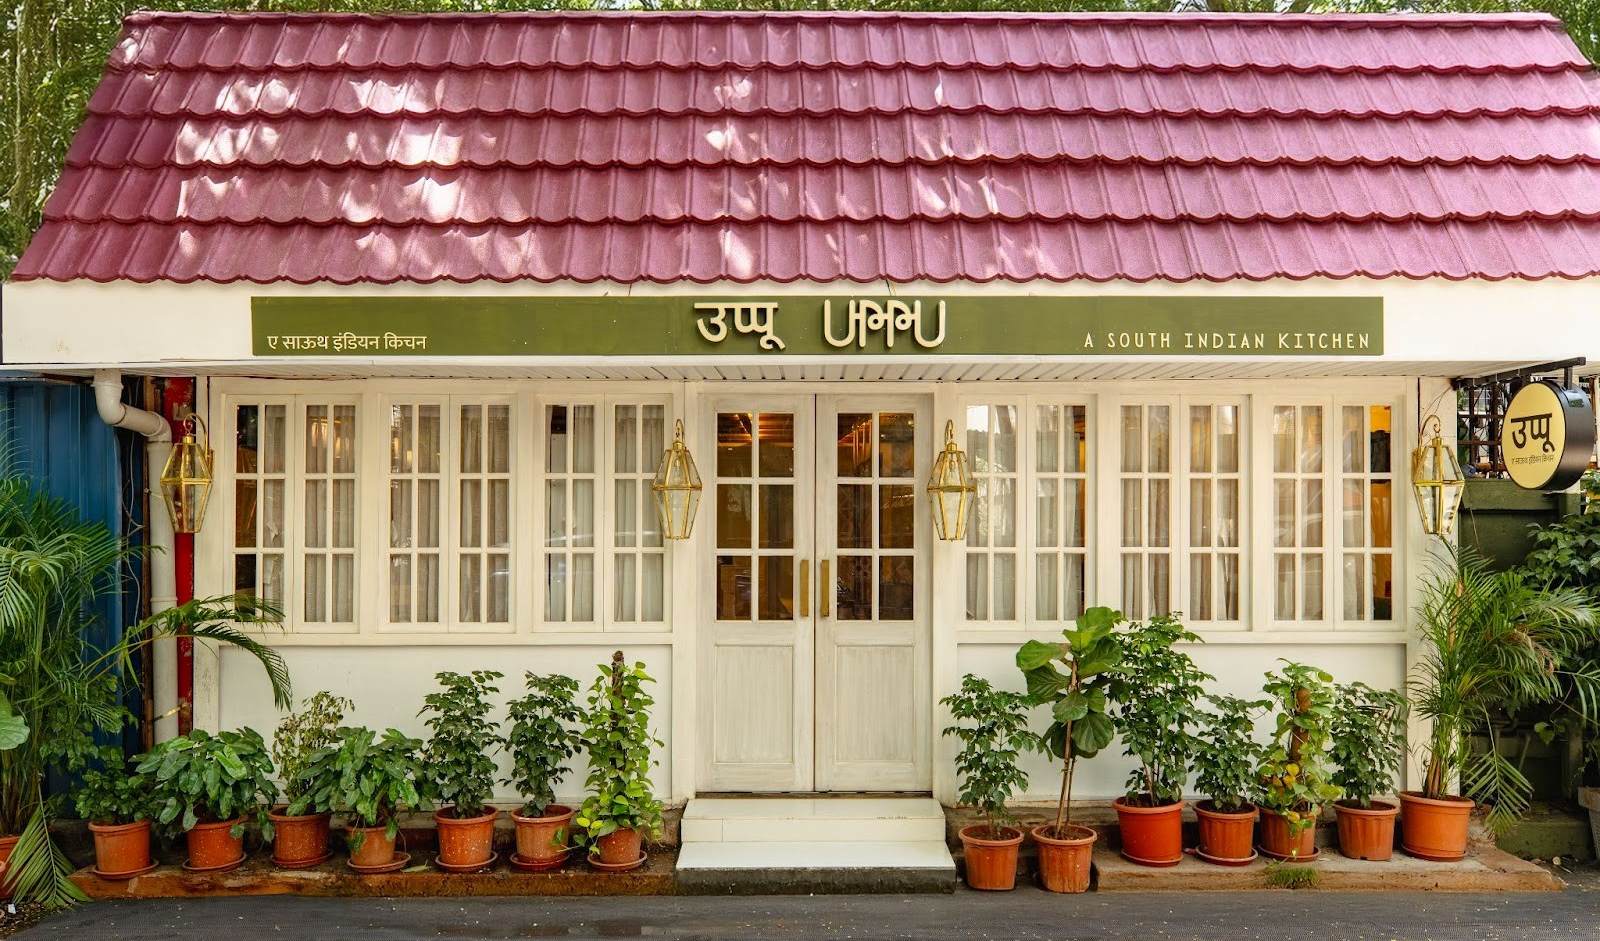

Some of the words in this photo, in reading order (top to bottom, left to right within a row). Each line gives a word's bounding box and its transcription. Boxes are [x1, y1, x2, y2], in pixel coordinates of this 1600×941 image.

[267, 335, 278, 350] ए
[282, 335, 329, 349] साऊथ
[332, 331, 379, 352] इंडियन
[384, 331, 427, 350] किचन
[694, 302, 786, 350] उप्पू
[1084, 331, 1094, 348] A
[1107, 332, 1171, 348] SOUTH
[1184, 332, 1265, 349] INDIAN
[1278, 332, 1370, 349] KITCHEN
[1510, 412, 1556, 453] उप्पू
